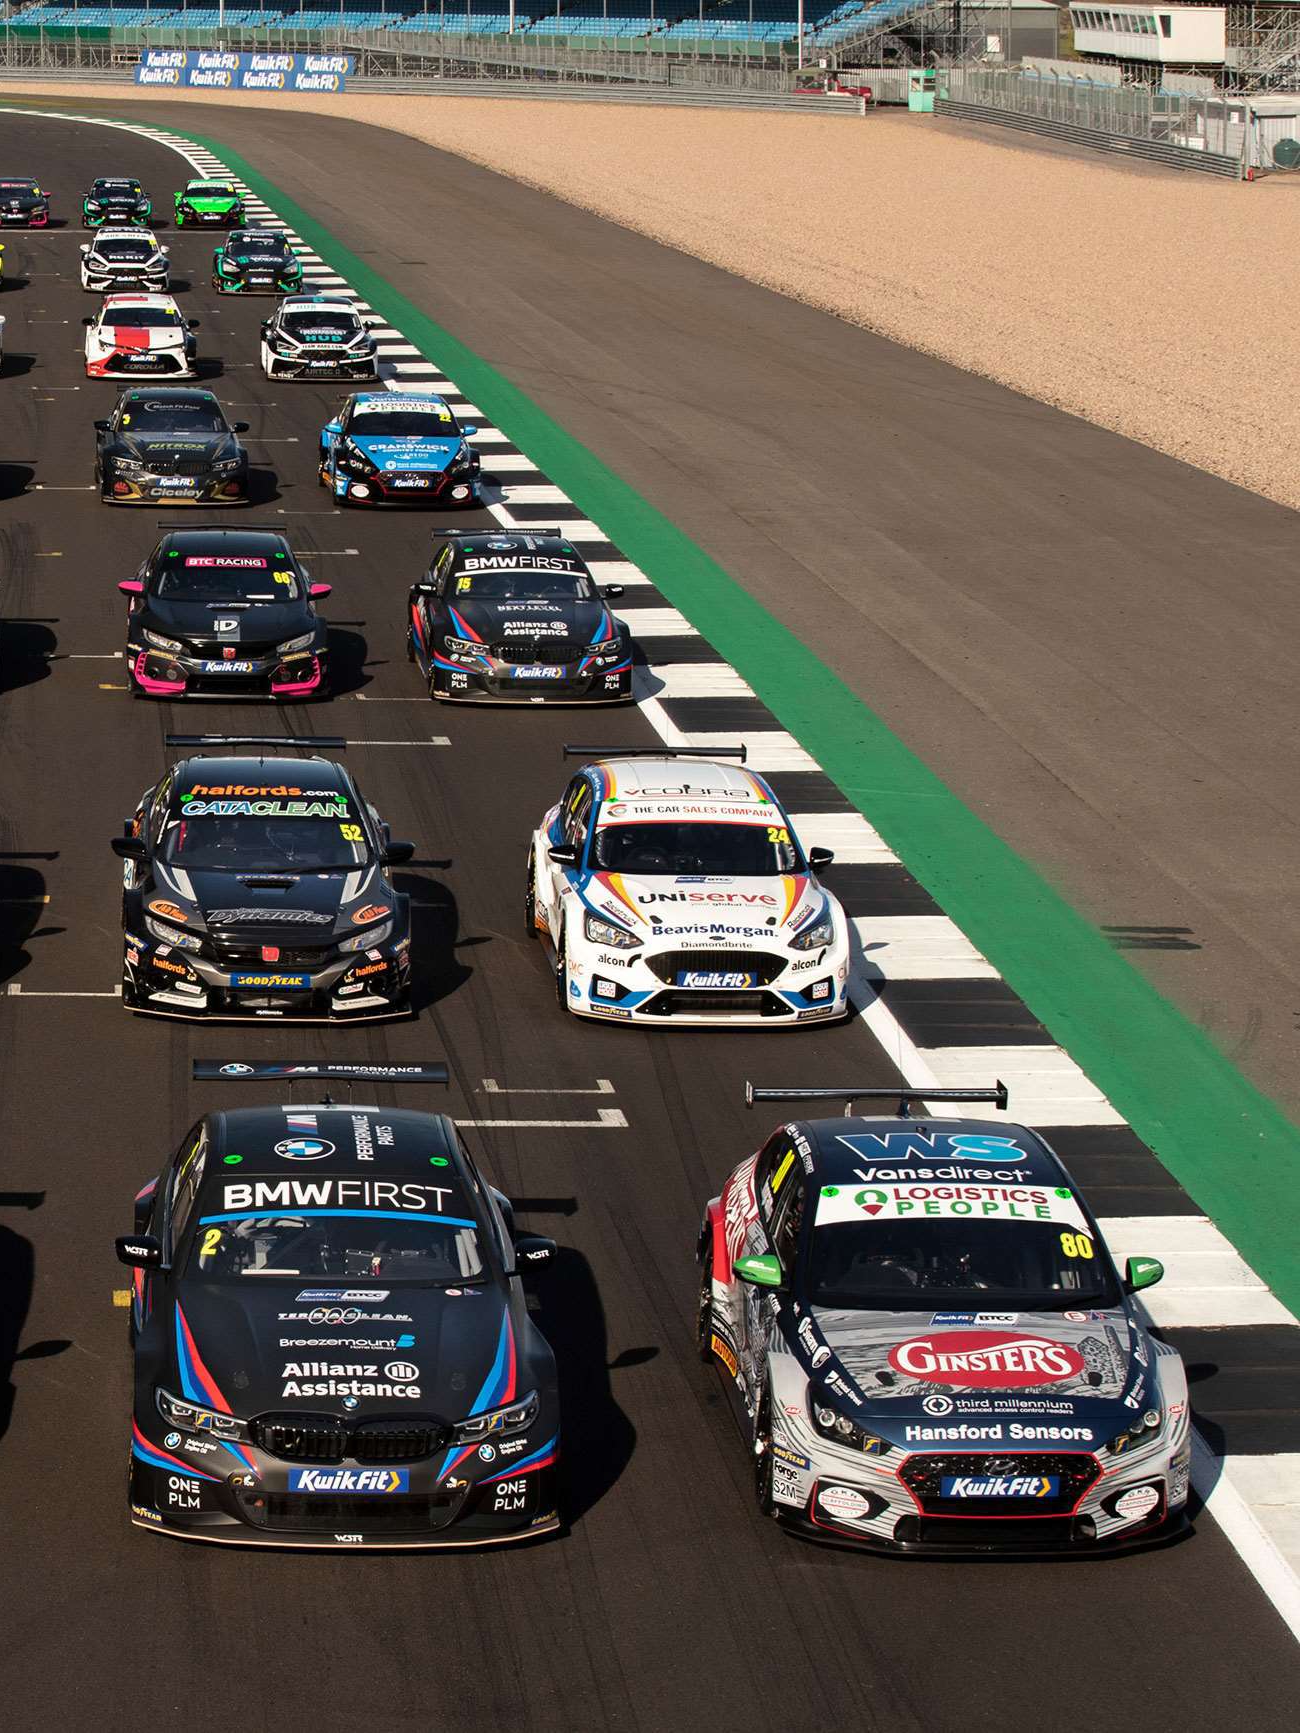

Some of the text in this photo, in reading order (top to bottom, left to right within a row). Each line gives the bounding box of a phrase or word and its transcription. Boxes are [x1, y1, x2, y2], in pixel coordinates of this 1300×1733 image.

[123, 414, 130, 424] 3
[439, 413, 451, 422] 22
[368, 444, 450, 452] CRANSWICK
[150, 488, 204, 497] Ciceley
[216, 558, 261, 566] RACING
[458, 577, 471, 590] 15
[504, 628, 568, 636] Assistance
[452, 680, 467, 689] PLM
[605, 674, 620, 682] ONE
[182, 801, 350, 818] CATACLEAN
[683, 806, 718, 815] SALES
[721, 807, 773, 817] COMPANY
[340, 825, 364, 841] 52
[768, 828, 790, 844] 24
[681, 941, 753, 949] Diamondbrite
[153, 957, 186, 974] halfords
[598, 954, 626, 967] alcon
[791, 959, 817, 971] alcon
[356, 962, 387, 976] halfords
[237, 976, 303, 986] GOODYEAR
[327, 1065, 422, 1074] PERFORMANCE
[357, 1114, 375, 1161] PERFORMANCE
[378, 1125, 393, 1146] PARTS
[835, 1133, 1028, 1162] WS
[894, 1187, 1048, 1205] LOGISTICS
[897, 1201, 1051, 1219] PEOPLE
[200, 1229, 222, 1255] 2
[1060, 1233, 1093, 1259] 80
[279, 1338, 396, 1347] Breezemount
[282, 1362, 379, 1378] Allianz
[282, 1381, 421, 1399] Assistance
[957, 1400, 1073, 1409] third millennium
[905, 1424, 1093, 1441] Hansford Sensors
[774, 1460, 798, 1480] Forge
[169, 1476, 200, 1493] ONE
[497, 1480, 526, 1495] ONE
[773, 1480, 796, 1499] S2M
[169, 1493, 200, 1508] PLM
[494, 1496, 525, 1511] PLM
